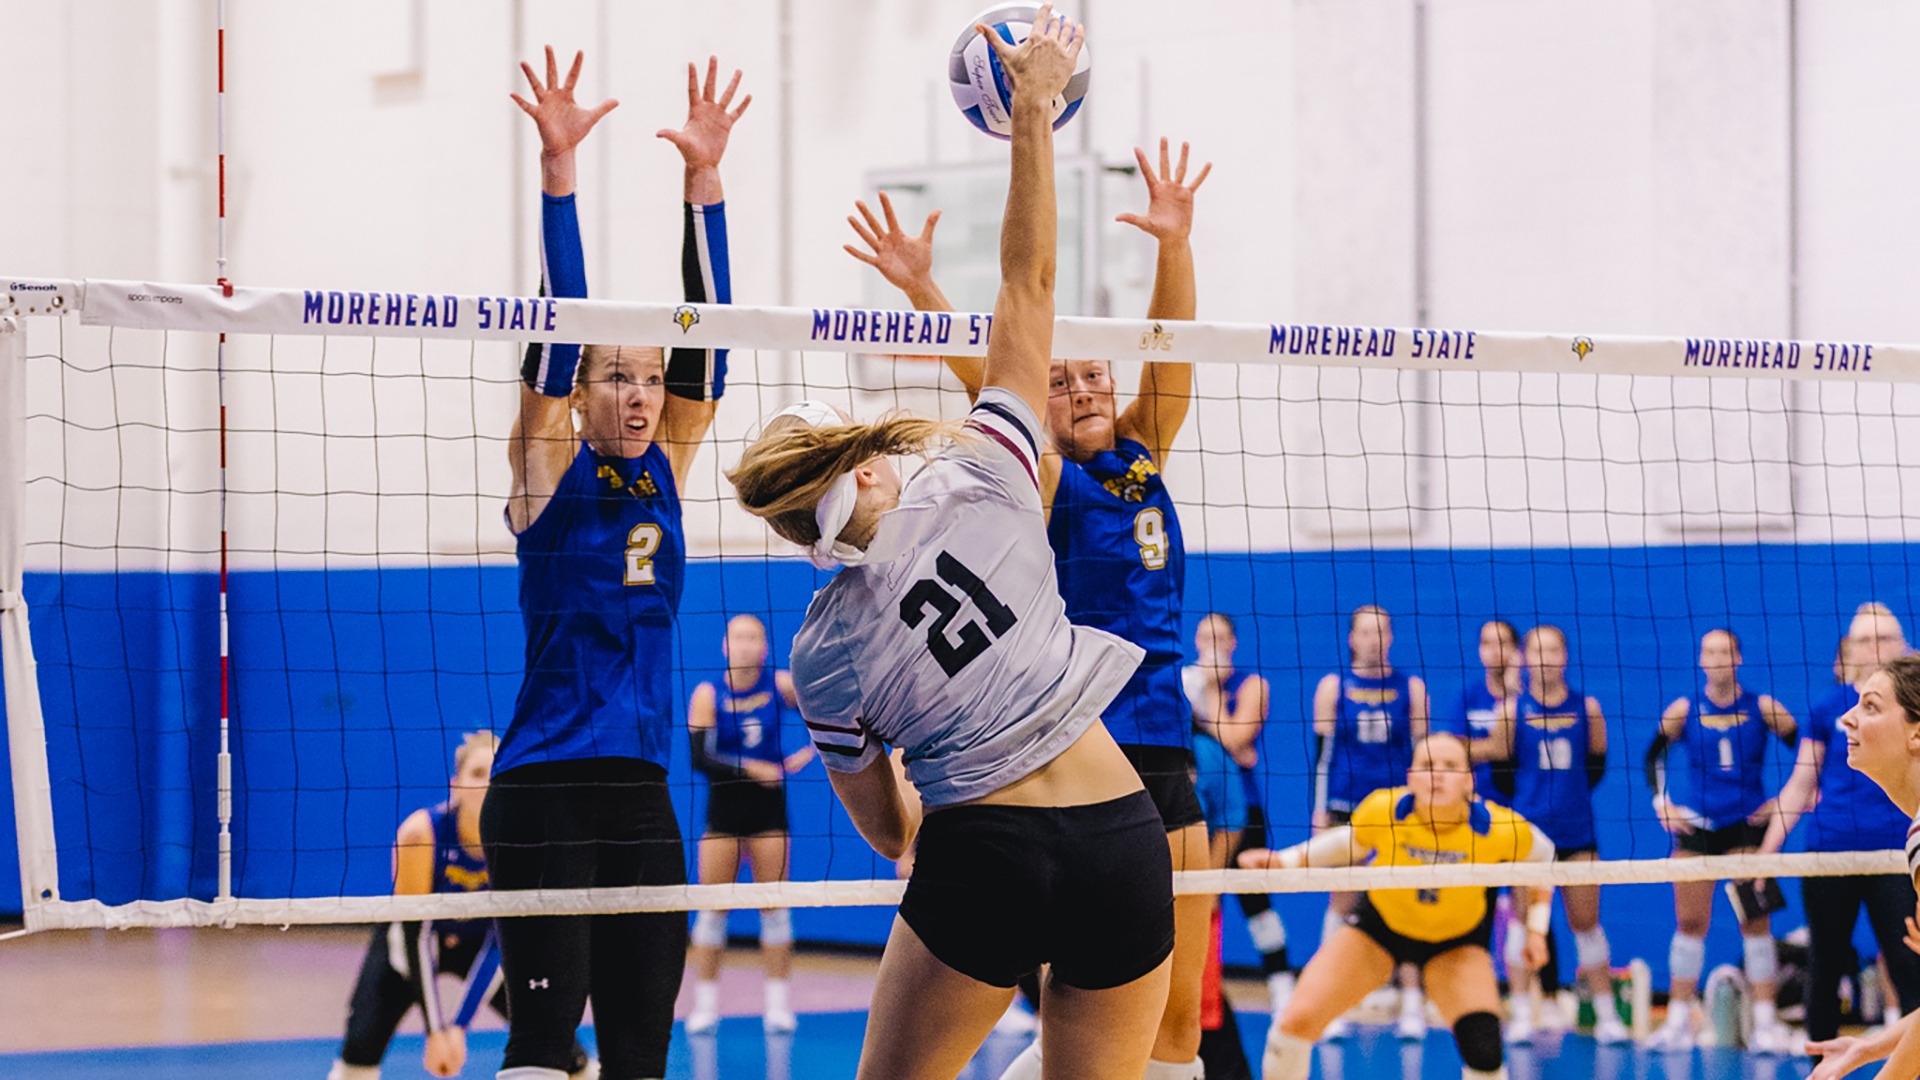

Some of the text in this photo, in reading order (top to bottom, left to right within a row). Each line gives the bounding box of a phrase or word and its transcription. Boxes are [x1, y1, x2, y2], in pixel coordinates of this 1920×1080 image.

[303, 291, 557, 332] MOREHEAD STATE
[811, 309, 952, 344] MOREHEAD
[1139, 331, 1174, 352] OVC
[1268, 325, 1476, 360] MOREHEAD STATE
[1685, 338, 1874, 372] MOREHEAD STATE
[623, 523, 663, 586] 2
[1133, 506, 1169, 571] 9
[899, 549, 1019, 679] 21
